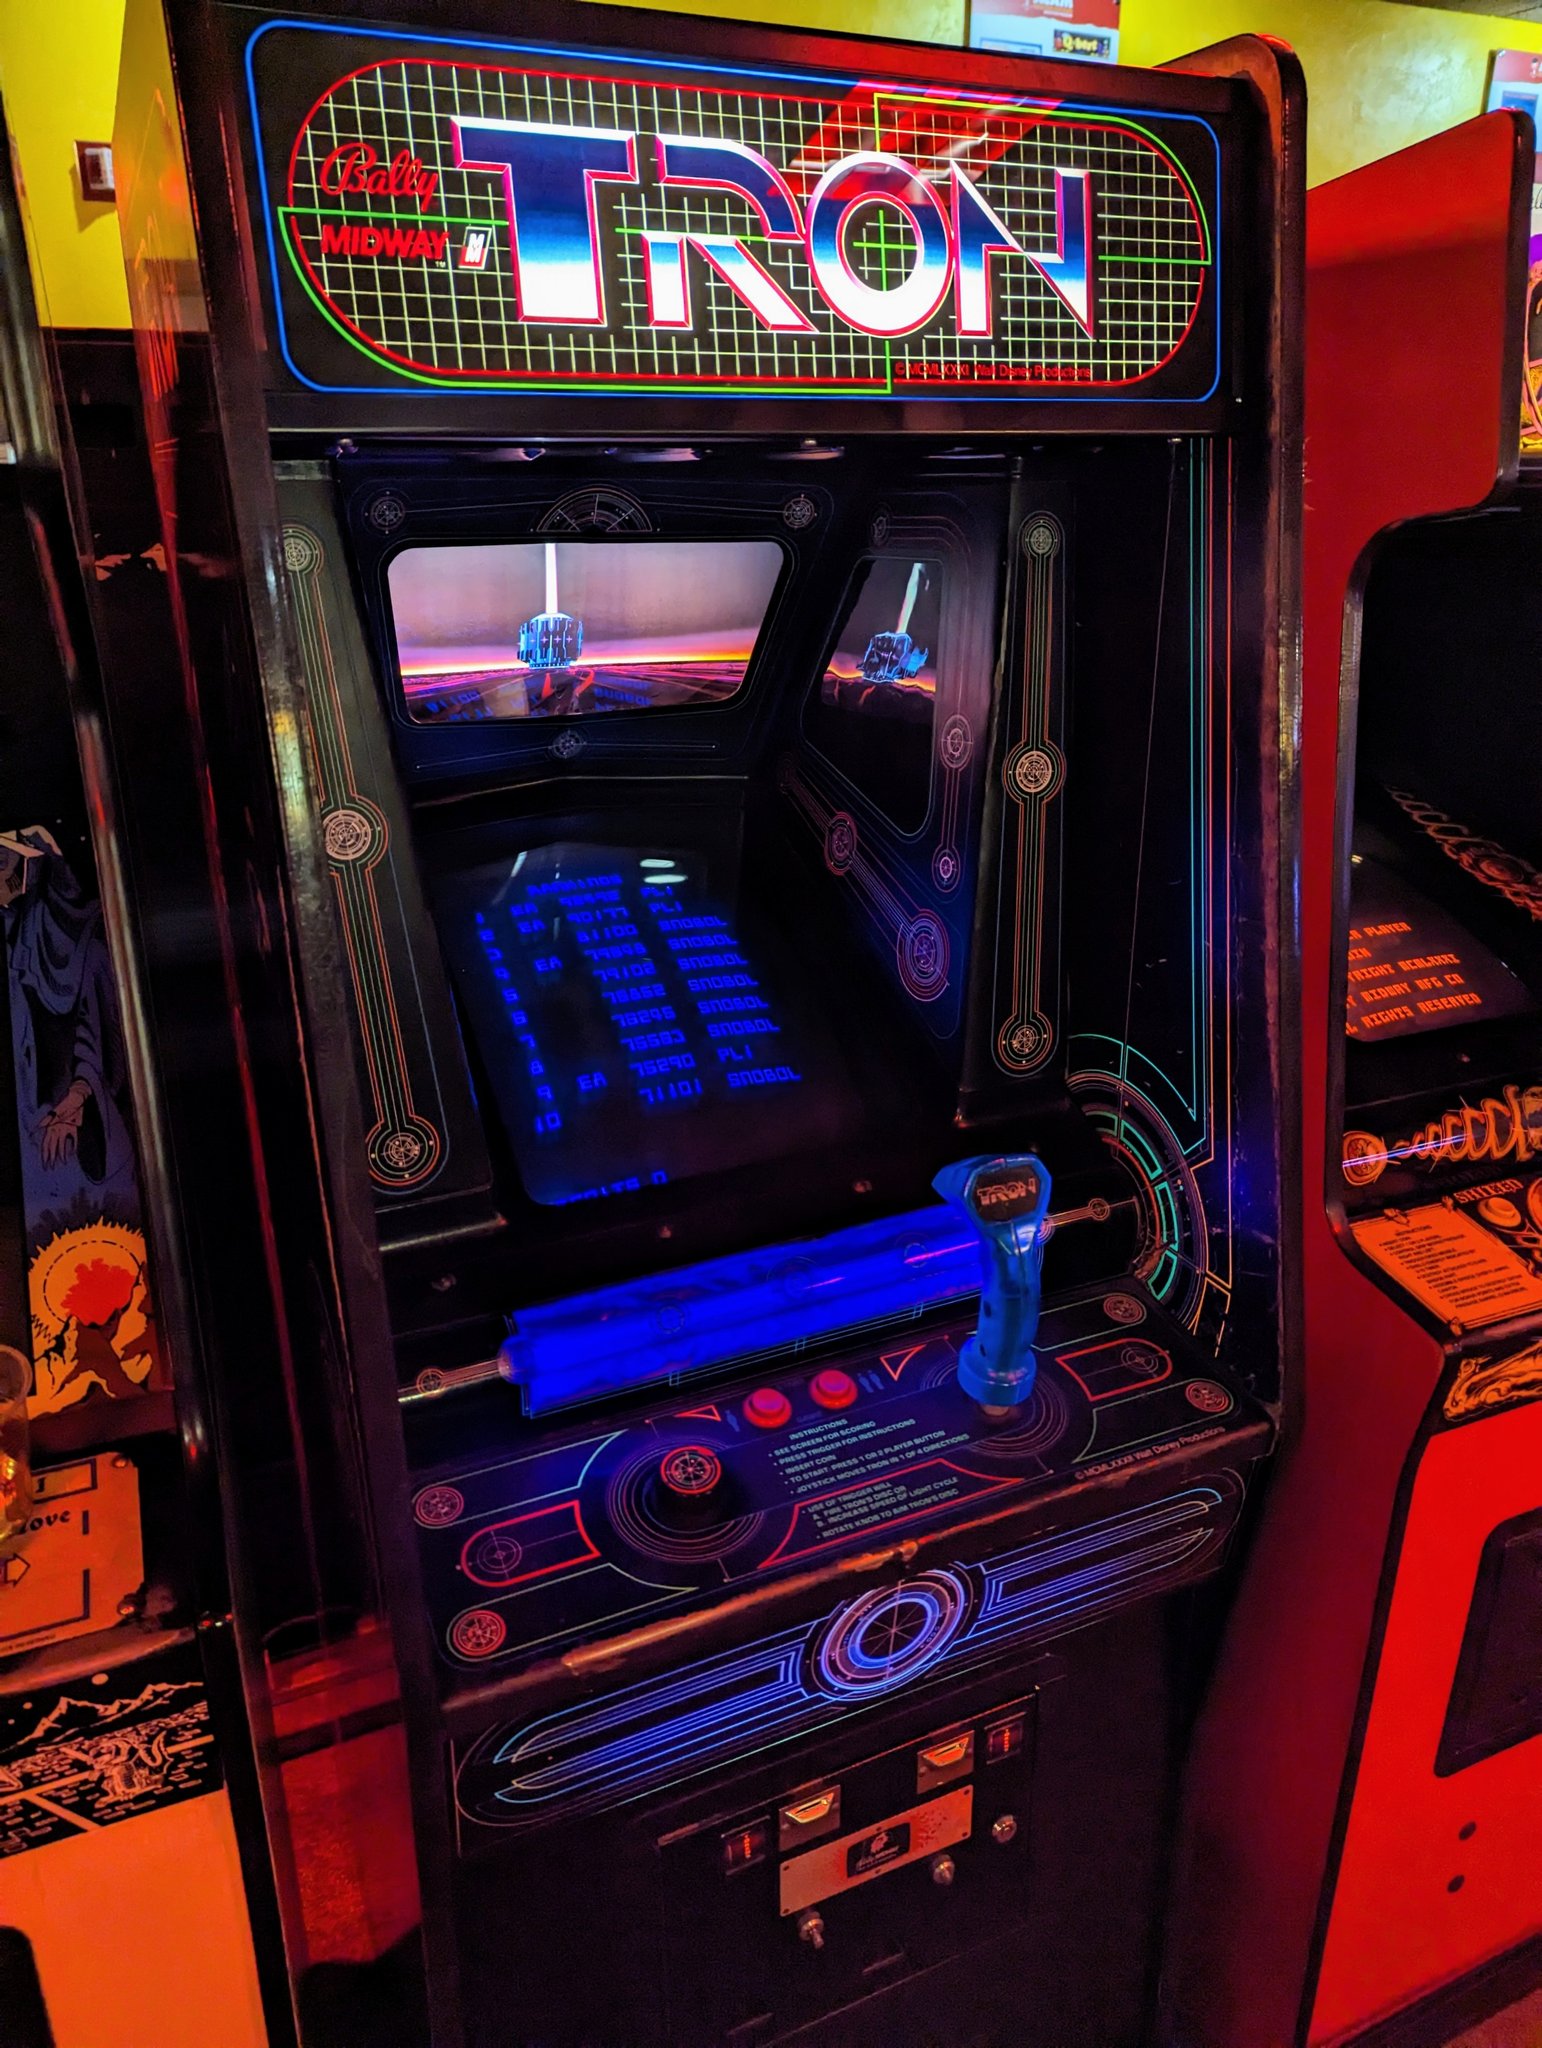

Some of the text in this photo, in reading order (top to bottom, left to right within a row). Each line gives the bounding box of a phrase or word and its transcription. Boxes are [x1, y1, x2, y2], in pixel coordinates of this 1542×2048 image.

[320, 142, 438, 212] Bally
[321, 225, 448, 260] MIDWAY
[450, 115, 1095, 340] TRON
[974, 364, 996, 376] Walt
[999, 364, 1033, 378] Disney
[1034, 365, 1091, 378] Productions
[668, 935, 739, 950] SNOBOL
[1363, 921, 1412, 937] PLAYER
[678, 953, 748, 971] SNOBOL
[688, 973, 759, 992] SNOBOL
[1360, 982, 1412, 1003] MIDWAY
[1414, 976, 1444, 991] MFG
[1443, 972, 1465, 985] CO
[698, 996, 768, 1014] SNOBOL
[1360, 1005, 1415, 1029] RIGHTS
[1416, 992, 1483, 1014] RESERVED
[708, 1018, 780, 1038] SNOBOL
[577, 1072, 607, 1091] EA
[727, 1066, 802, 1088] SNOBOL
[977, 1177, 1037, 1206] TRON
[774, 1421, 876, 1457] SEE SCREEN FOR SCORING
[779, 1418, 916, 1465] PRESS TRIGGER FOR INSTRUCTIONS
[789, 1419, 848, 1440] INSTRUCTIONS
[1152, 1440, 1181, 1454] Disney
[1180, 1425, 1226, 1446] Productions
[785, 1454, 837, 1474] INSERT COIN
[790, 1475, 802, 1483] TO
[831, 1457, 859, 1470] PRESS
[884, 1440, 914, 1454] PLAYER
[913, 1430, 946, 1444] BUTTON
[797, 1477, 837, 1493] JOYSTICK
[837, 1466, 866, 1480] MOVES
[866, 1460, 890, 1471] TRON
[889, 1456, 900, 1464] IN
[905, 1450, 916, 1458] OF
[923, 1433, 970, 1453] DIRECTIONS
[807, 1481, 892, 1513] USE OF TRIGGER WILL
[823, 1506, 842, 1517] FIRE
[872, 1489, 894, 1500] DISC
[893, 1485, 907, 1494] OR
[827, 1505, 870, 1524] INCREASE
[869, 1496, 897, 1510] SPEED
[896, 1492, 908, 1501] OF
[908, 1484, 932, 1497] LIGHT
[932, 1476, 958, 1490] CYCLE
[822, 1522, 854, 1538] ROTATE
[854, 1514, 881, 1527] KNOB
[880, 1510, 893, 1518] TO
[892, 1504, 909, 1515] AIM
[938, 1488, 959, 1499] DISC
